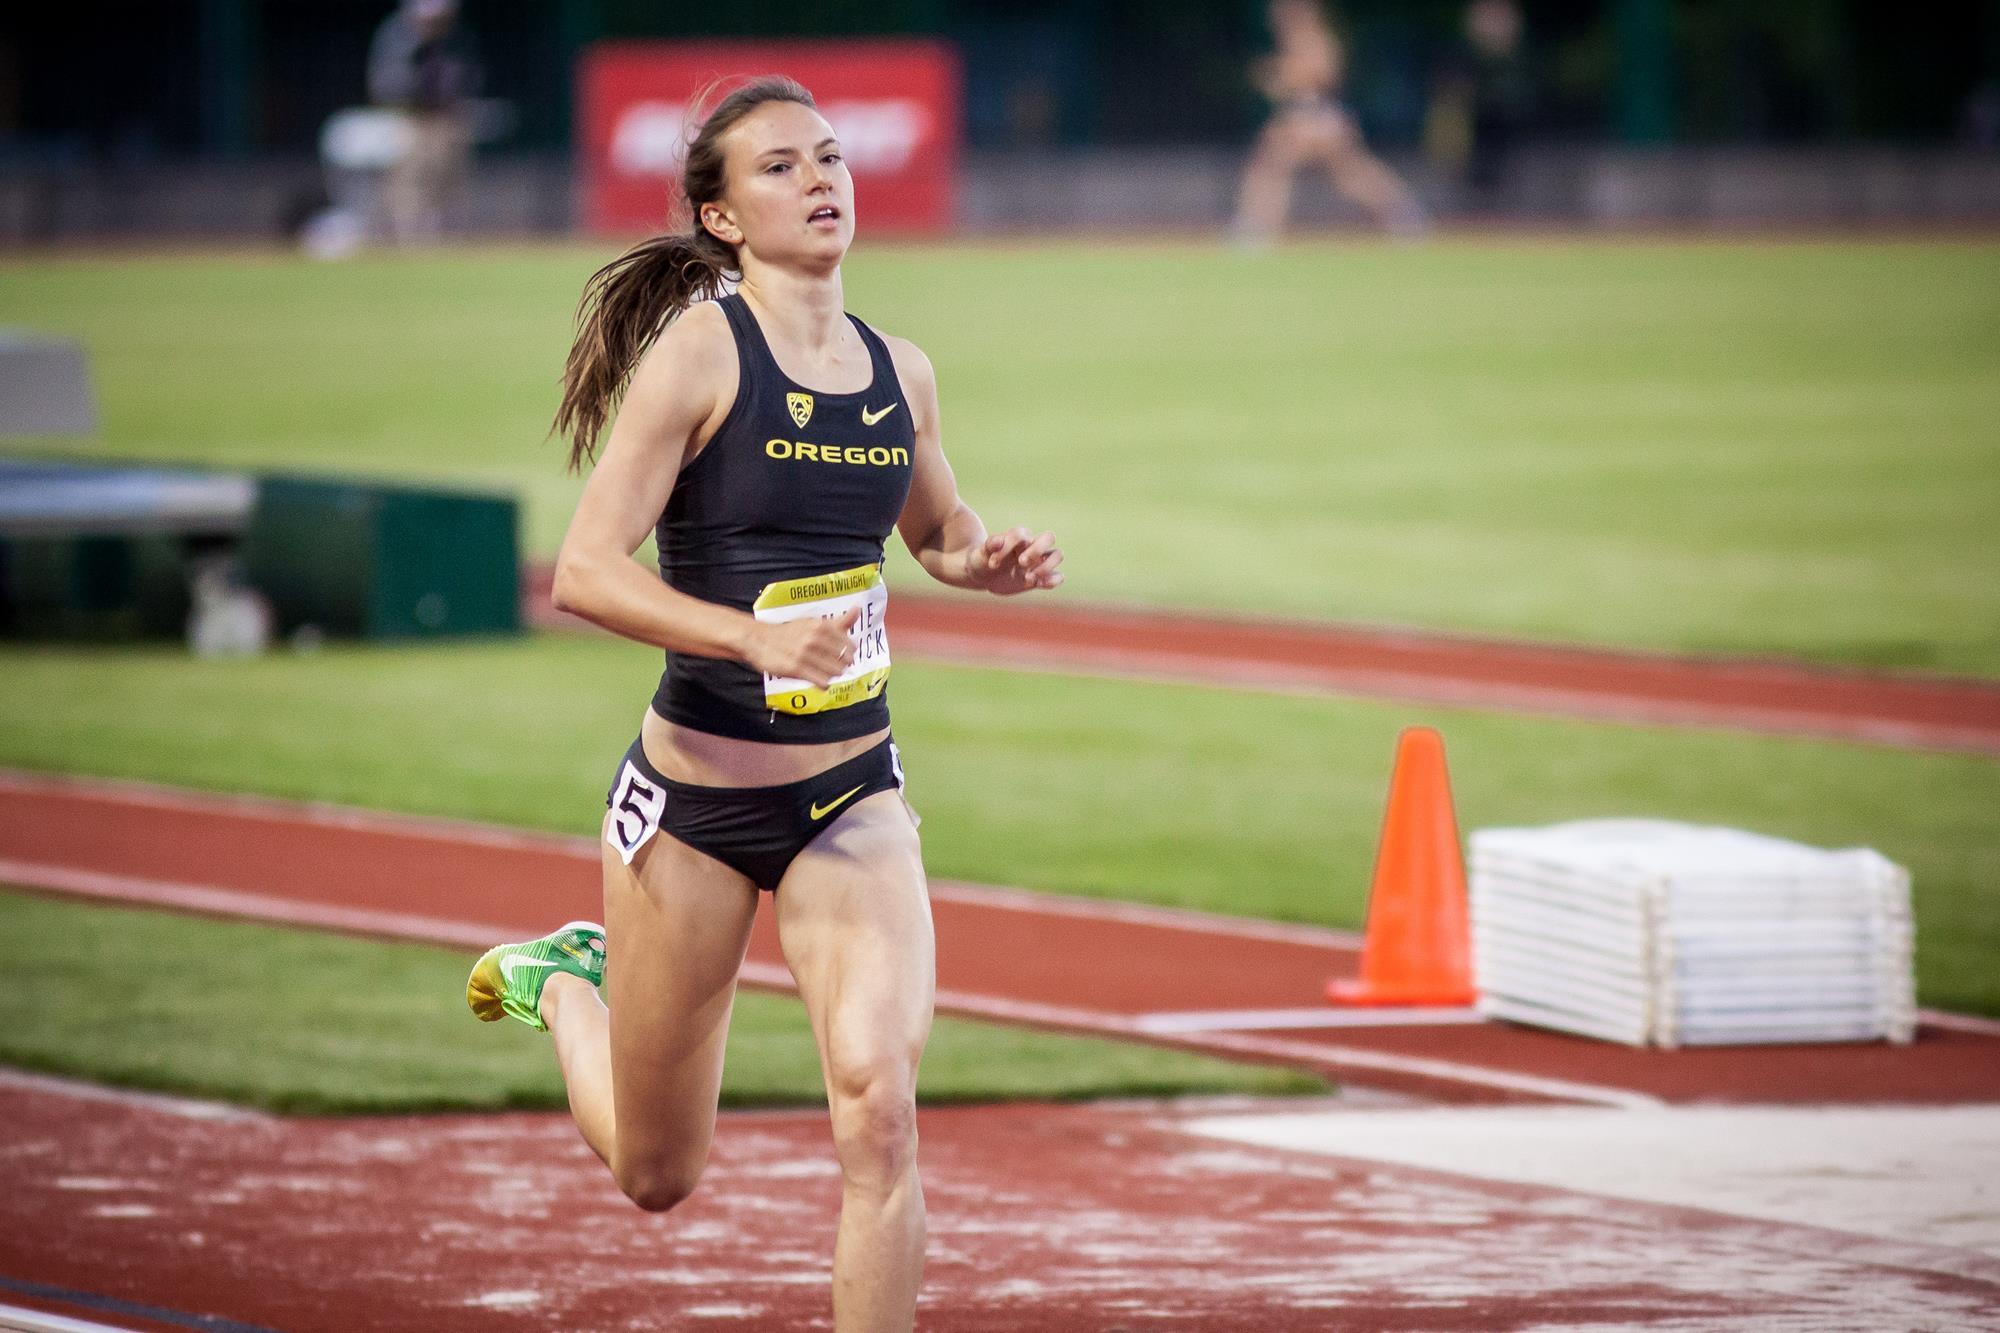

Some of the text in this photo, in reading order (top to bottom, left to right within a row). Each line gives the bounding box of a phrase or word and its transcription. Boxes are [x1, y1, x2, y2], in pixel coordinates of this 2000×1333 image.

[765, 438, 909, 466] OREGON
[790, 573, 866, 600] OREGON TWILIGHT
[616, 776, 655, 851] 5
